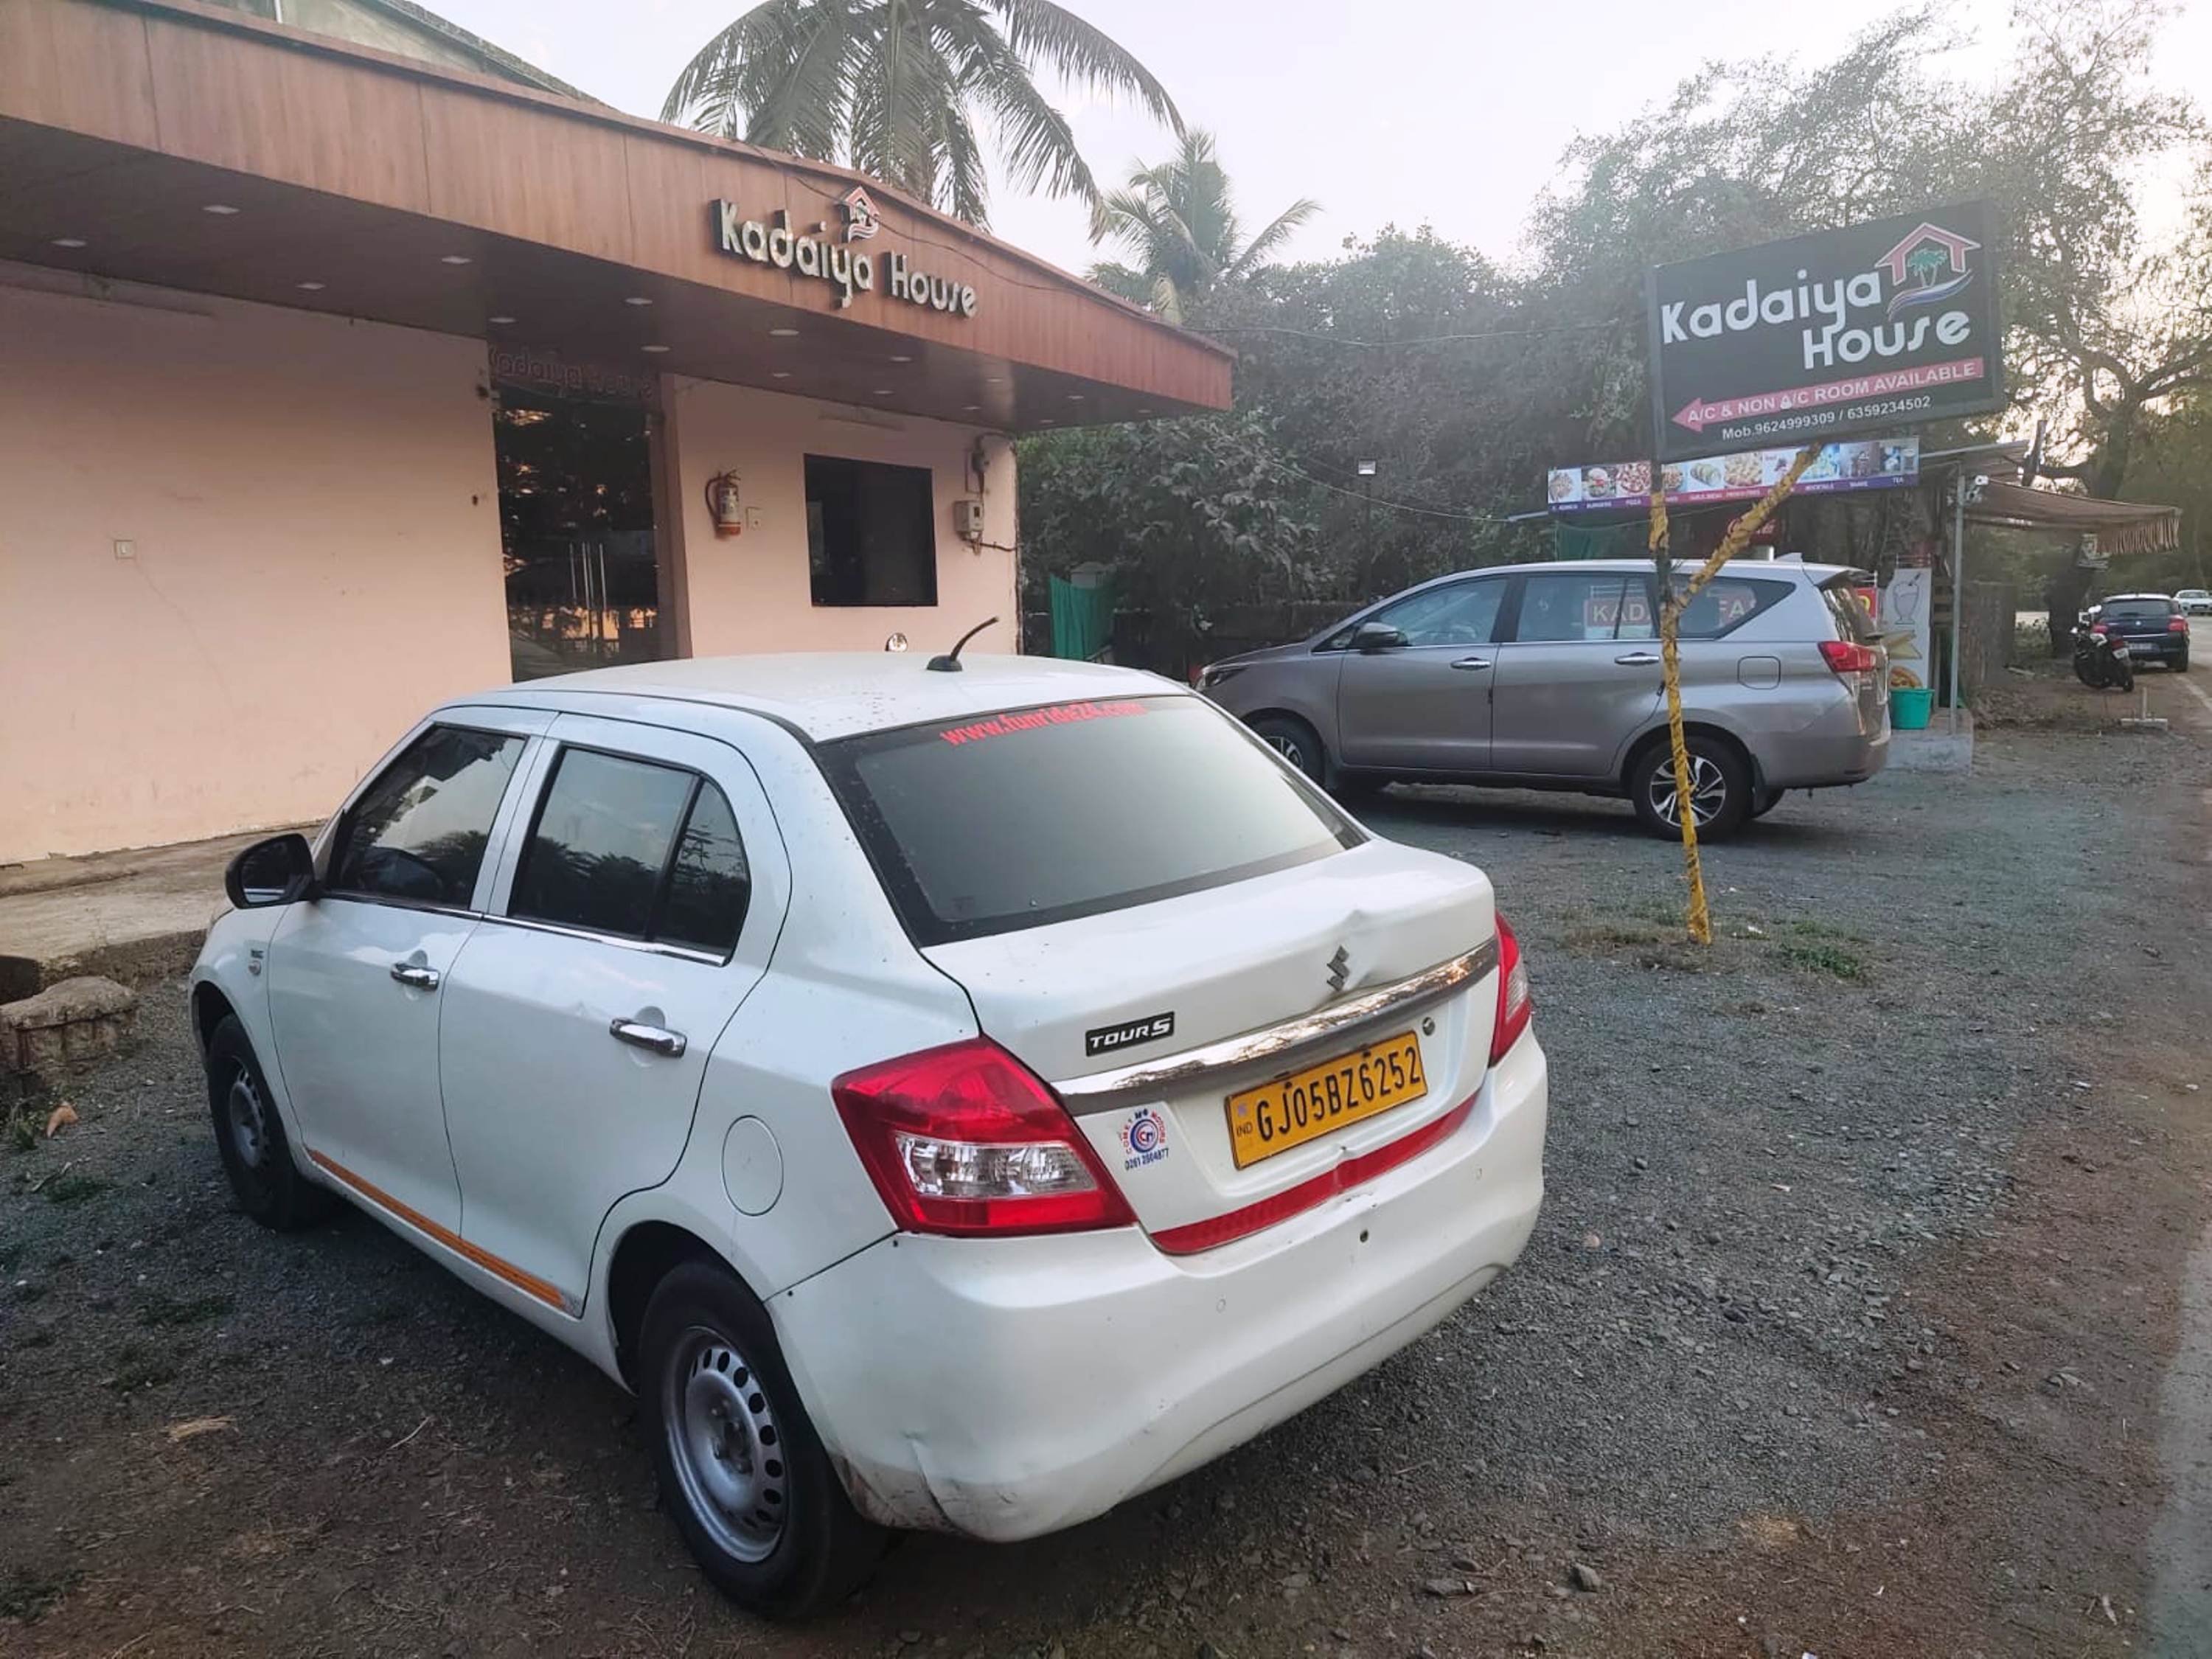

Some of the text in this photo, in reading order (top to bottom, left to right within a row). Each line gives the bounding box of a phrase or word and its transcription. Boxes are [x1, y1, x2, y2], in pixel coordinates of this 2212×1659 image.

[717, 199, 978, 319] Kadaiya House
[1660, 268, 1972, 369] Kadaiya House
[1688, 406, 1716, 423] A/C
[1721, 403, 1733, 418] &
[1738, 397, 1775, 414] NON
[1814, 380, 1870, 402] ROOM
[1874, 363, 1976, 392] AVAILABLE
[1847, 395, 1932, 420] 6359234502
[1237, 1121, 1253, 1137] IND
[1256, 1046, 1421, 1141] GJ05BZ6252
